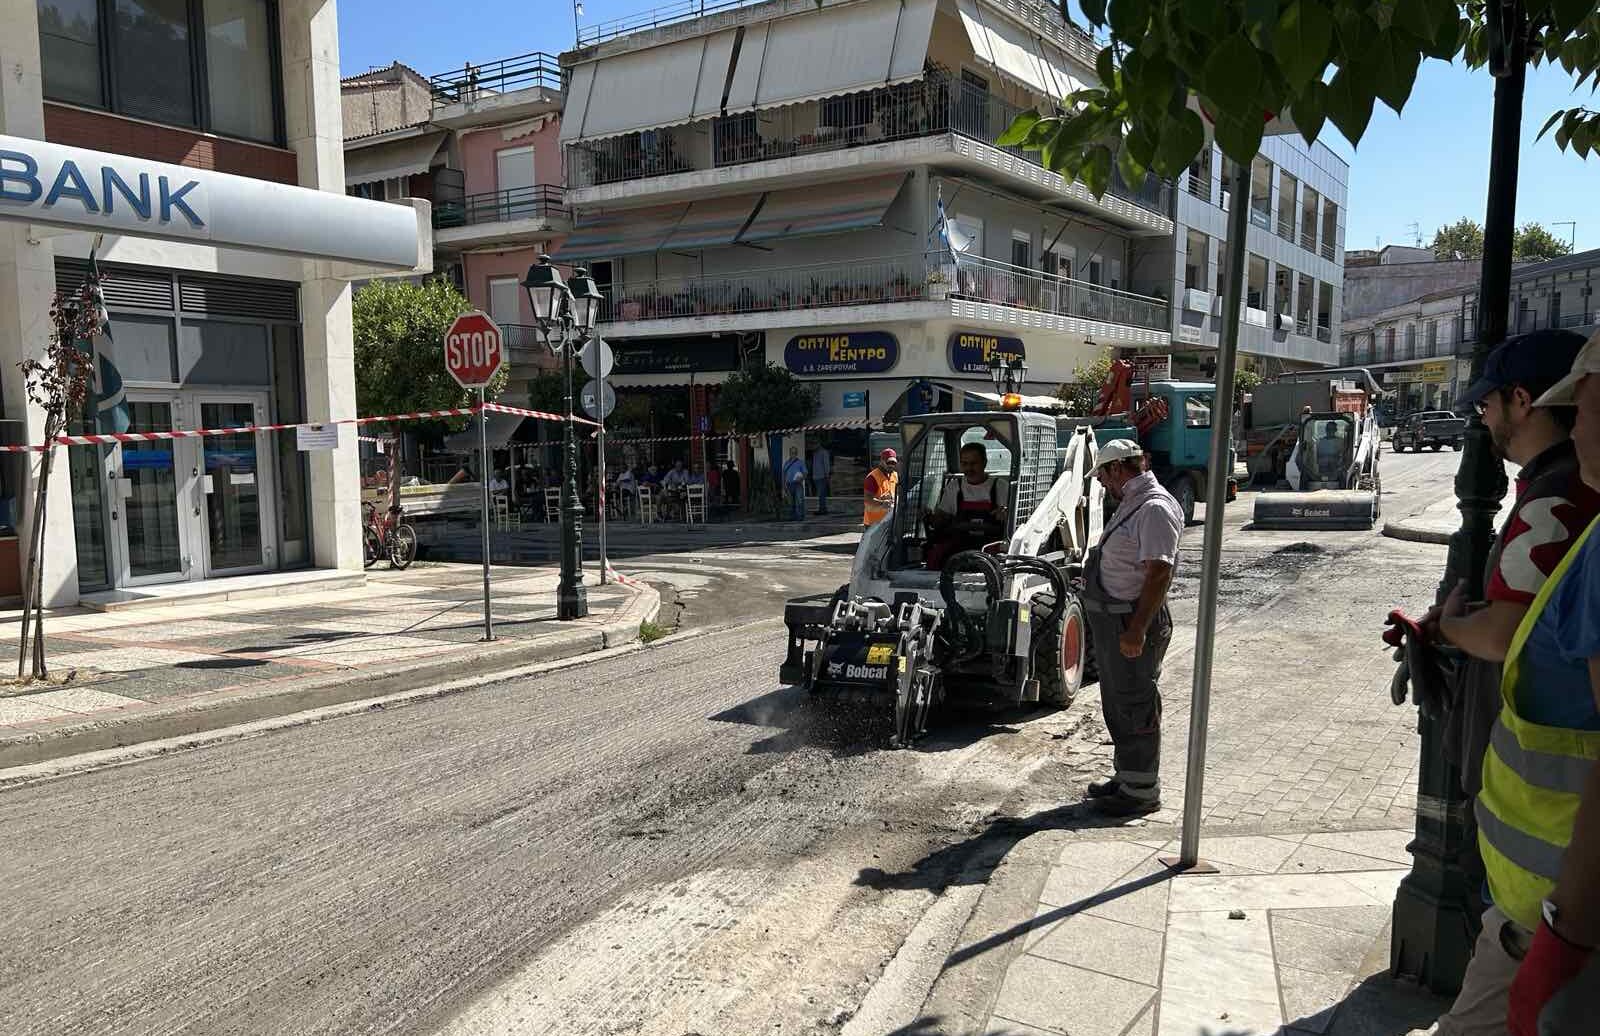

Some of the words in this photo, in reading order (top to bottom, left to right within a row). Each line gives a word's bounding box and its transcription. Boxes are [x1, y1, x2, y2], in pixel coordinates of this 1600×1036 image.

[0, 150, 205, 227] BANK
[450, 330, 497, 369] STOP
[798, 335, 849, 351] ΟΠΤΙΚΟ
[830, 347, 887, 361] ΚΕΝΤΡΟ
[846, 663, 888, 680] Bobcat
